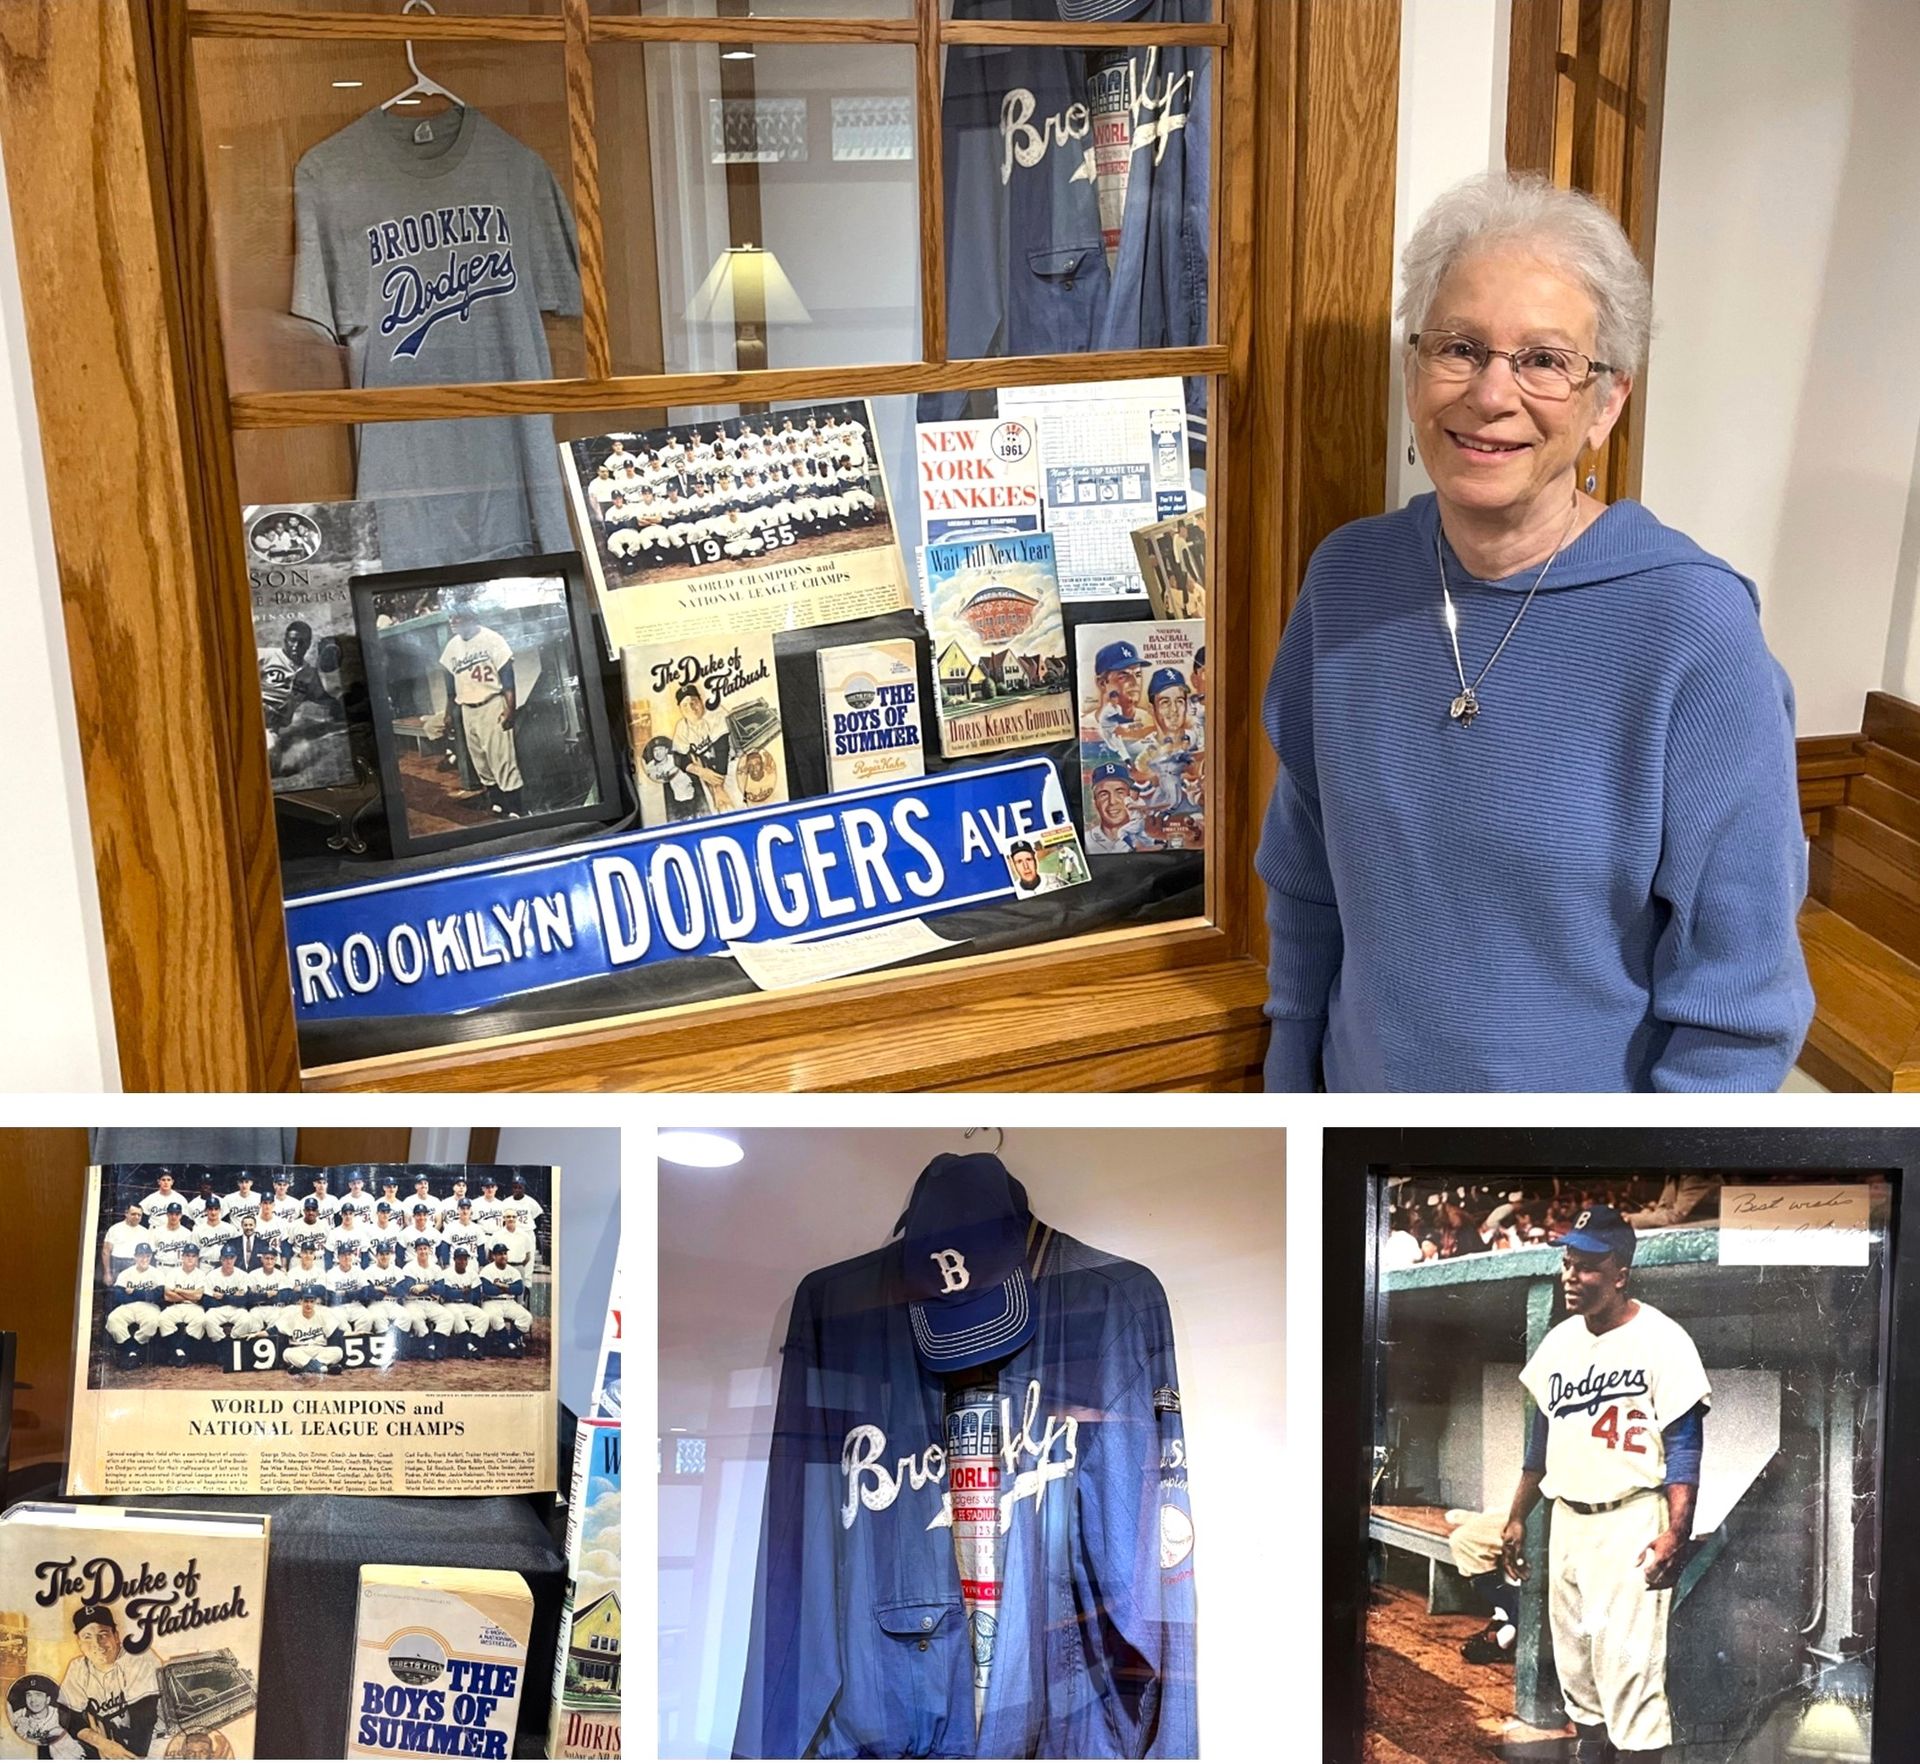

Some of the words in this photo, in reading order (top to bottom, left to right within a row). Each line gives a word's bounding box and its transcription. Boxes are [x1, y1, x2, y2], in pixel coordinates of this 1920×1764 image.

[380, 248, 518, 342] Dodgers
[920, 430, 980, 454] NEW
[1000, 444, 1023, 457] 1961
[921, 459, 995, 482] YORK
[1090, 467, 1104, 476] TOP
[1106, 467, 1125, 475] TASTE
[1126, 465, 1146, 474] TEAM
[923, 485, 1037, 512] YANKEES
[690, 539, 722, 566] 19
[762, 523, 796, 551] 55
[930, 549, 961, 573] Wait
[963, 543, 987, 568] Till
[989, 543, 1020, 567] Next
[1020, 540, 1051, 562] Year
[678, 589, 744, 611] NATIONAL
[747, 581, 800, 601] LEAGUE
[801, 572, 851, 591] CHAMPS
[687, 578, 735, 594] WORLD
[738, 565, 813, 586] CHAMPIONS
[816, 560, 836, 574] and
[274, 591, 347, 606] PORTRA
[1143, 642, 1162, 651] HALL
[1164, 642, 1171, 650] of
[1173, 641, 1194, 649] FAME
[1148, 634, 1189, 643] BASEBALL
[1160, 650, 1193, 659] MUSEUM
[452, 650, 490, 674] Dodgers
[471, 665, 494, 683] 42
[651, 658, 681, 693] The
[678, 654, 725, 687] Duke
[727, 646, 742, 672] of
[703, 658, 770, 712] Flatbush
[876, 682, 915, 708] THE
[833, 708, 883, 735] BOYS
[885, 704, 908, 727] OF
[949, 719, 982, 742] DORIS
[984, 714, 1024, 738] KEARNS
[1025, 708, 1071, 731] GOODWIN
[834, 724, 920, 756] SUMMER
[1106, 763, 1116, 774] B
[294, 891, 573, 1005] ROOKLYN
[591, 796, 945, 965] DODGERS
[960, 800, 1033, 863] AVE
[1731, 1192, 1785, 1214] Best
[1788, 1191, 1854, 1211] wishes
[1574, 1211, 1592, 1229] B
[930, 1247, 970, 1294] B
[233, 1337, 277, 1372] 19
[345, 1335, 396, 1368] 55
[1548, 1363, 1648, 1418] Dodgers
[211, 1399, 284, 1416] WORLD
[292, 1399, 406, 1416] CHAMPIONS
[413, 1400, 445, 1416] and
[188, 1420, 293, 1437] NATIONAL
[301, 1420, 378, 1438] LEAGUE
[386, 1420, 466, 1437] CHAMPS
[1591, 1404, 1648, 1455] 42
[35, 1555, 85, 1607] The
[80, 1557, 168, 1607] Duke
[173, 1558, 201, 1598] of
[122, 1585, 250, 1655] Flatbush
[446, 1659, 518, 1698] THE
[361, 1681, 446, 1722] BOYS
[453, 1693, 498, 1728] OF
[358, 1714, 509, 1760] SUMMER
[565, 1712, 621, 1748] DORIS
